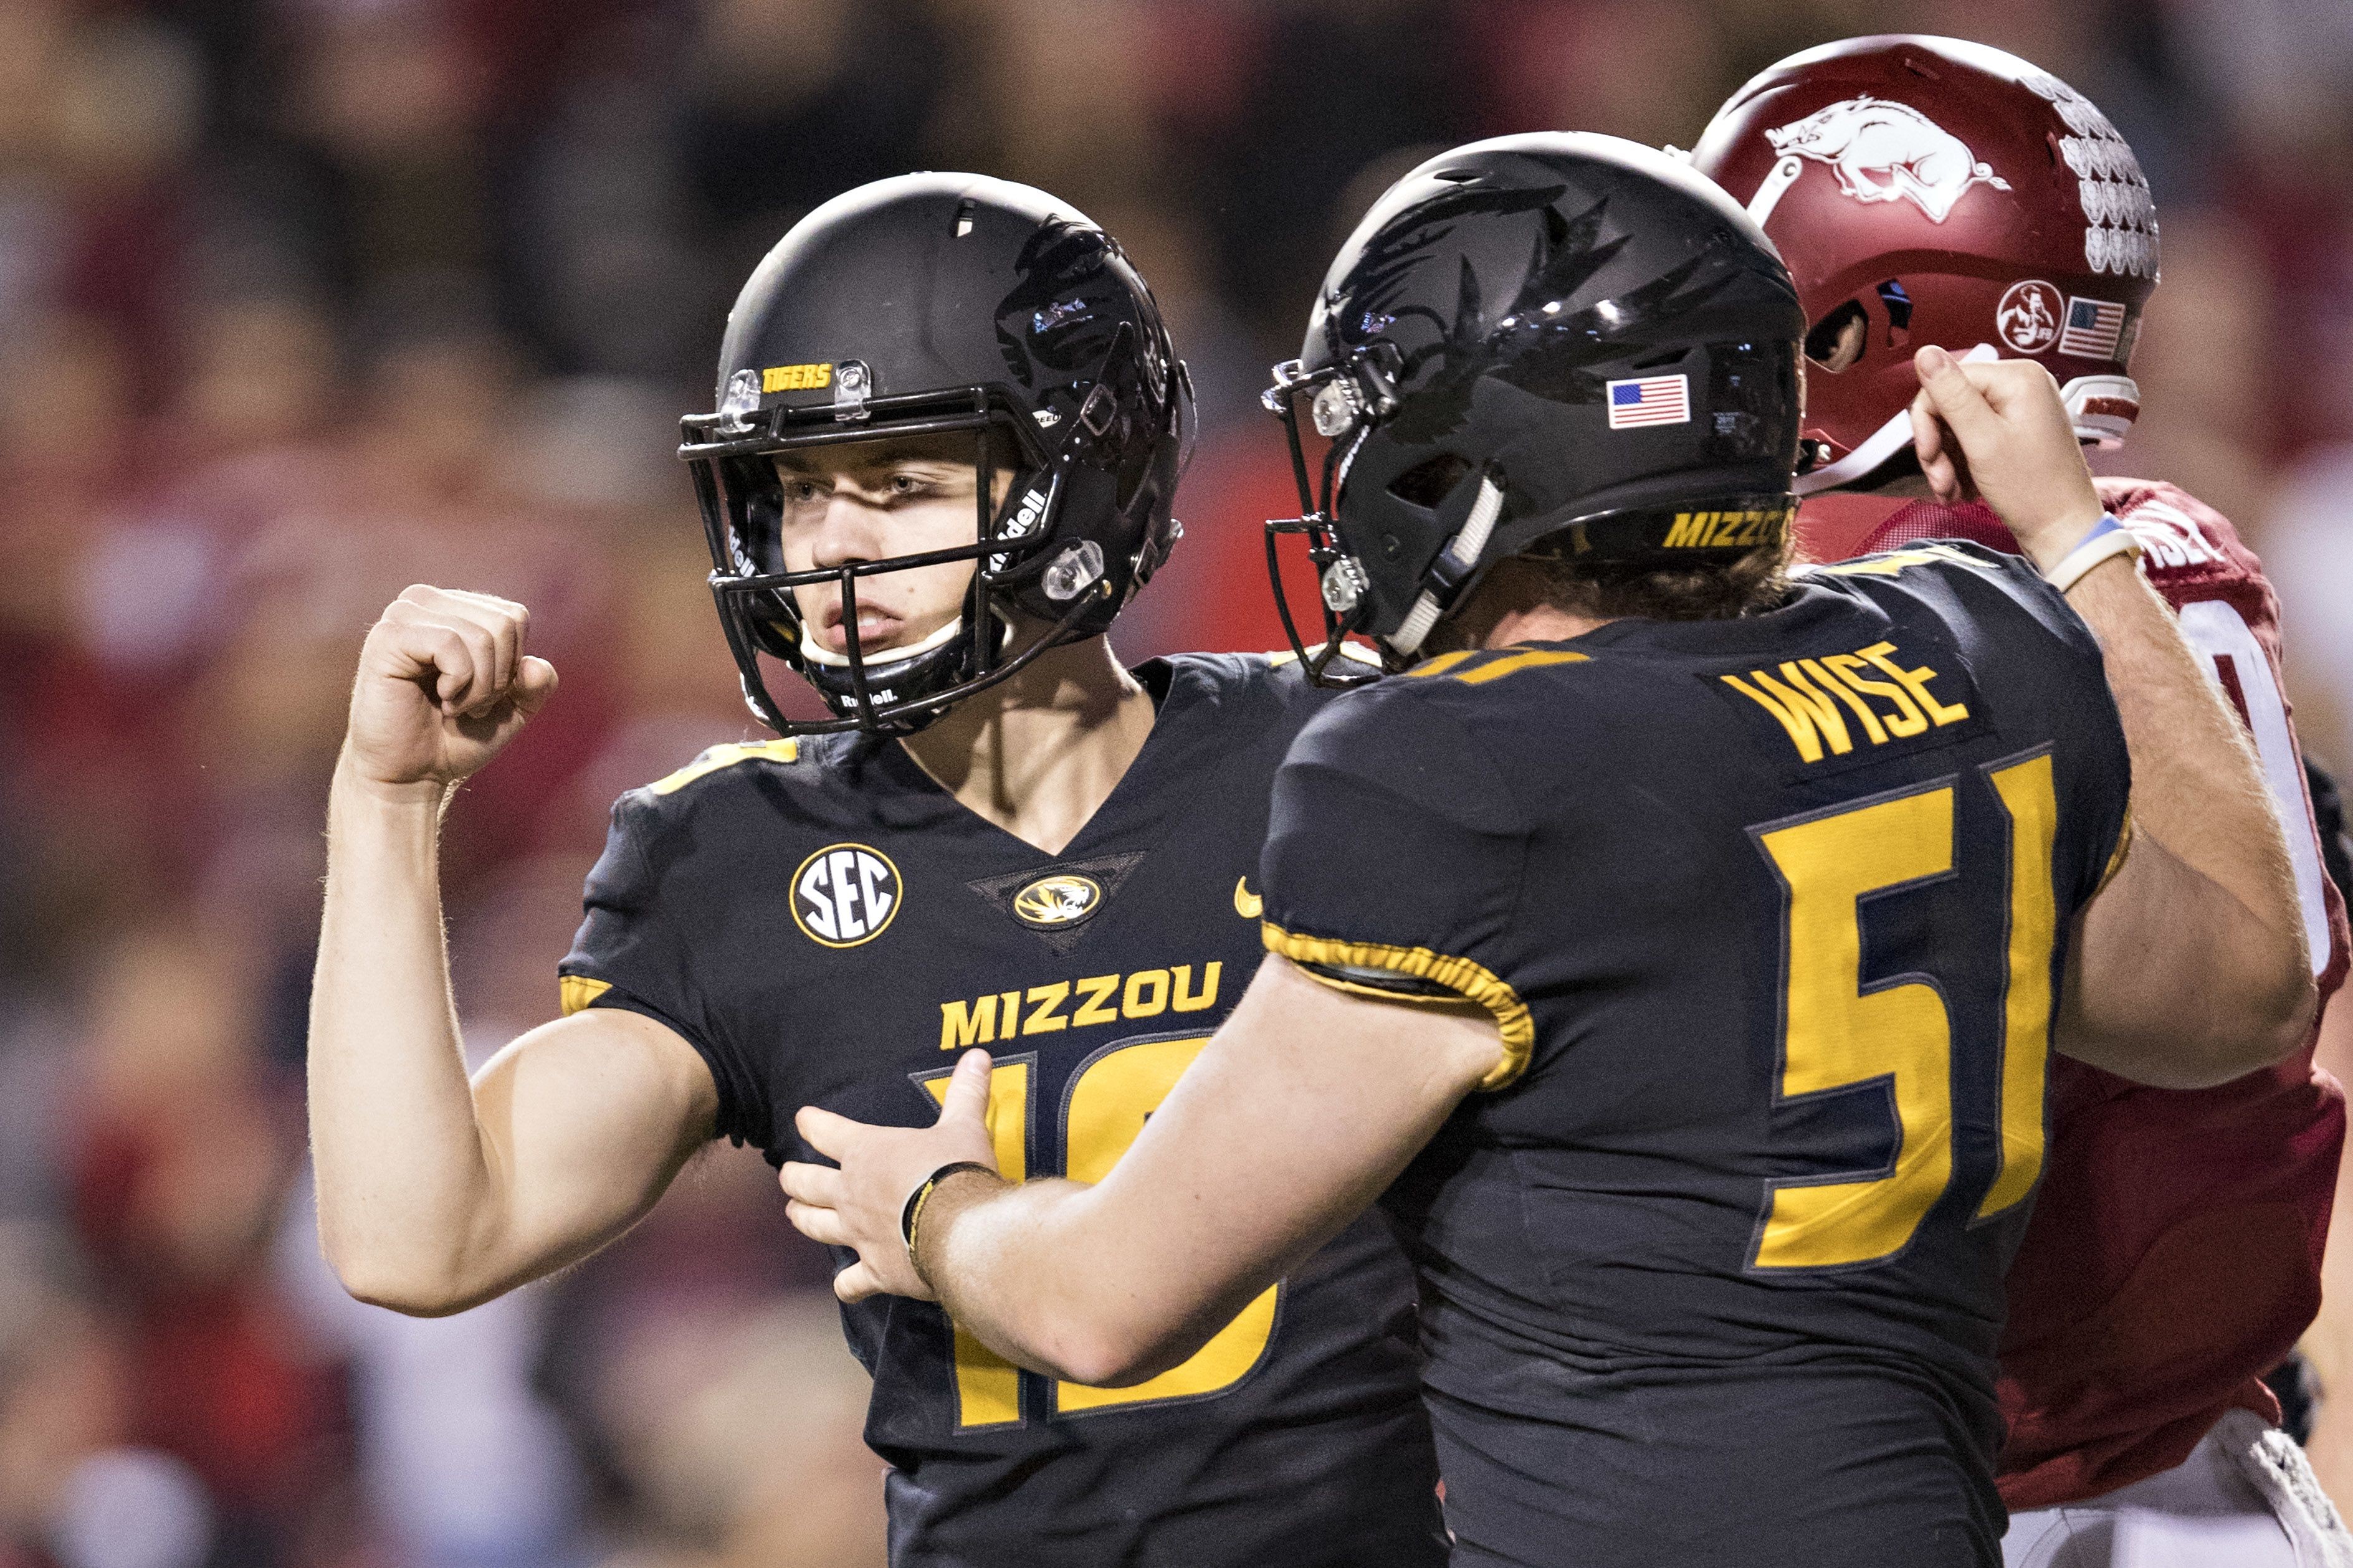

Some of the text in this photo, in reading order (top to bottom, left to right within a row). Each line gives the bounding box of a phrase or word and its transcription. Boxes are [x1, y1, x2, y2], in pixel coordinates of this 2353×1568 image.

[763, 363, 833, 393] TIGERS
[841, 689, 898, 707] Riell
[1721, 641, 1969, 764] WISE
[799, 850, 892, 939] SEC
[940, 961, 1223, 1050] MIZZOU
[1746, 741, 2056, 1275] 51
